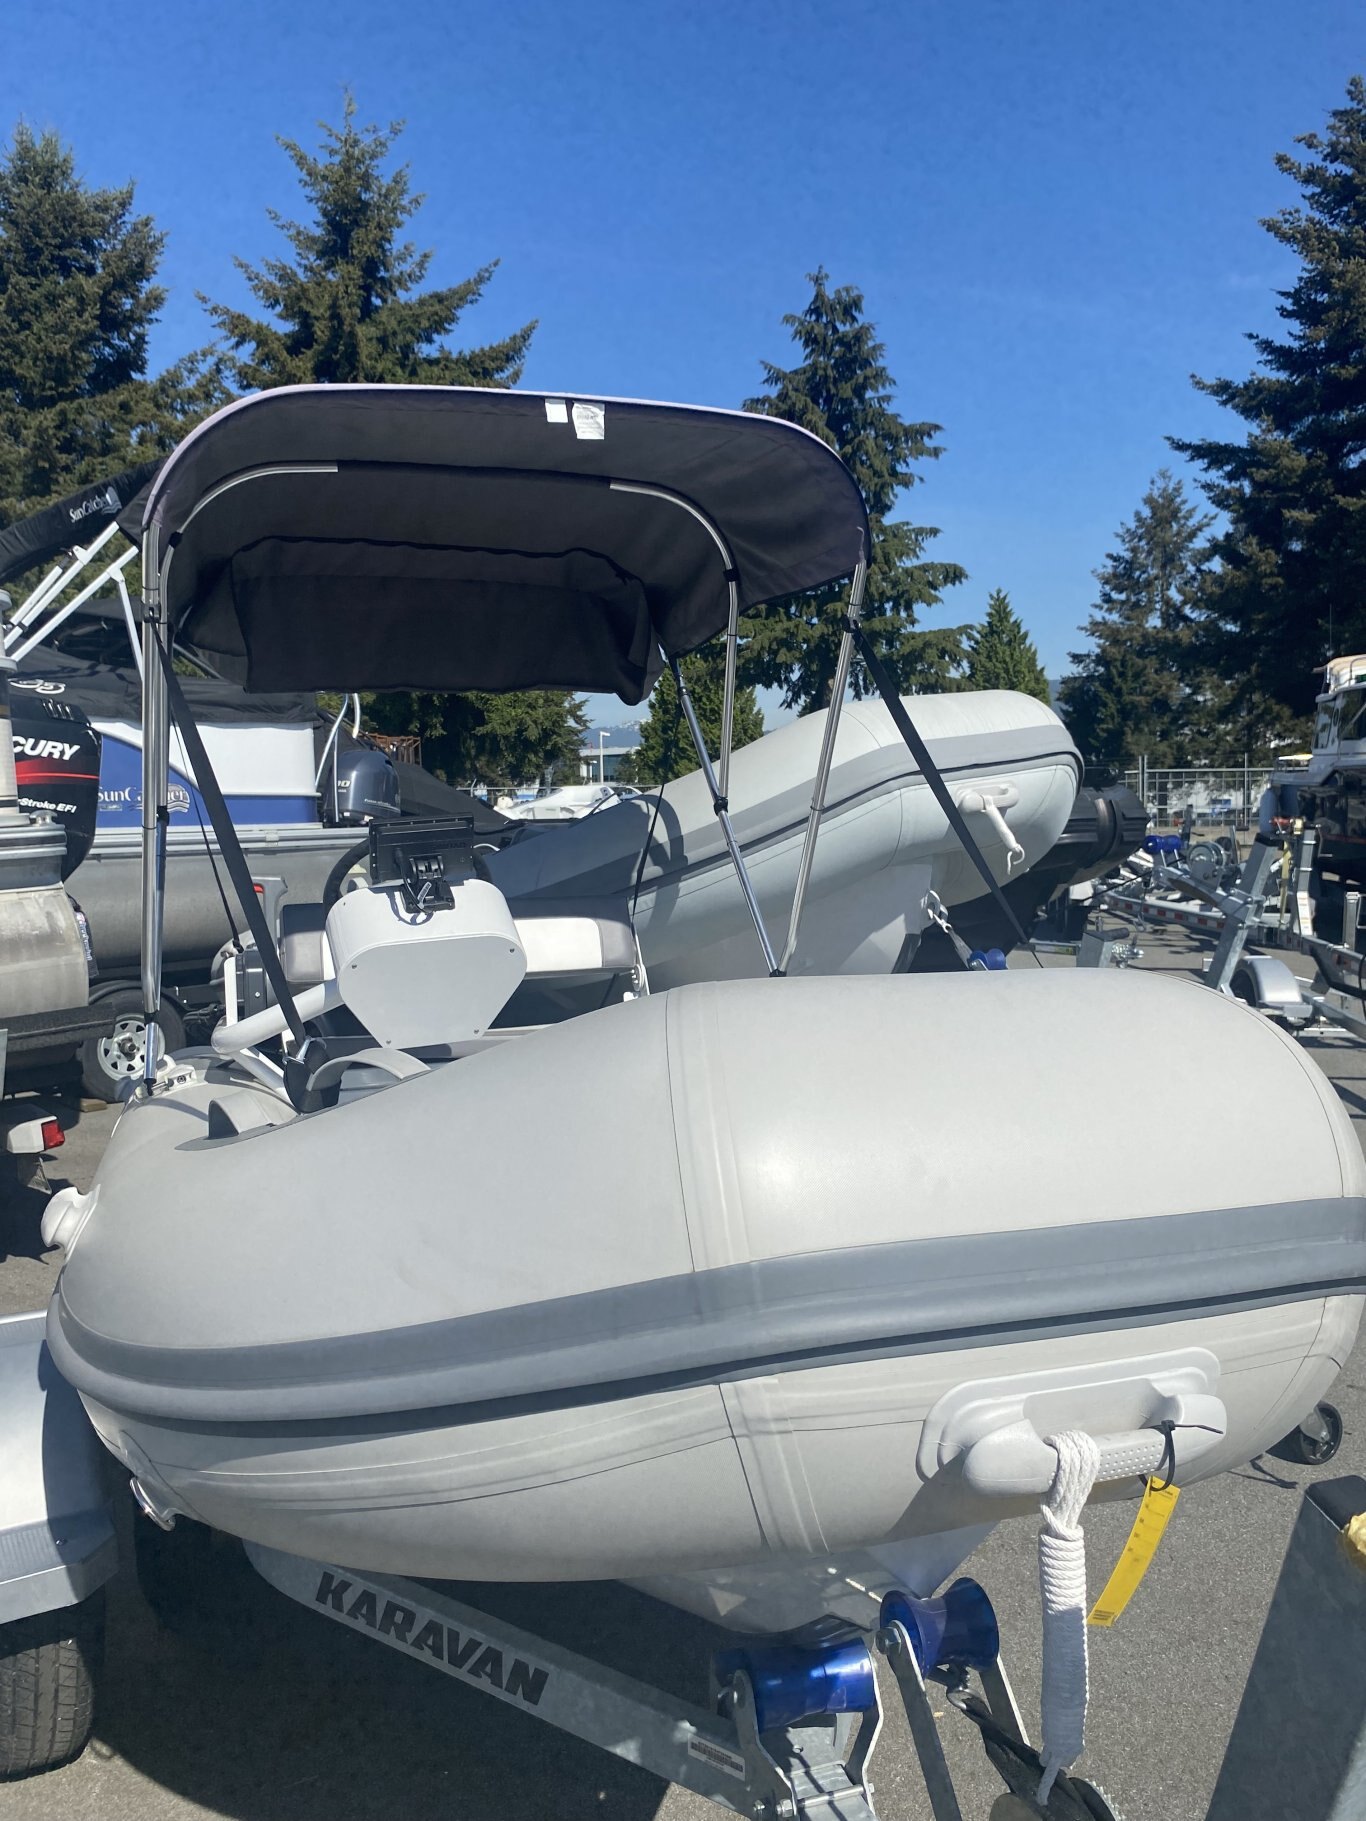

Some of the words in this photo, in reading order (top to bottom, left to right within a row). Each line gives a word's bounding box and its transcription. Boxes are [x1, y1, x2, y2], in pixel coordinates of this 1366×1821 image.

[12, 736, 80, 760] CURY
[18, 798, 56, 811] Stroke
[56, 802, 77, 813] EFI
[316, 1571, 549, 1706] KARAVAN
